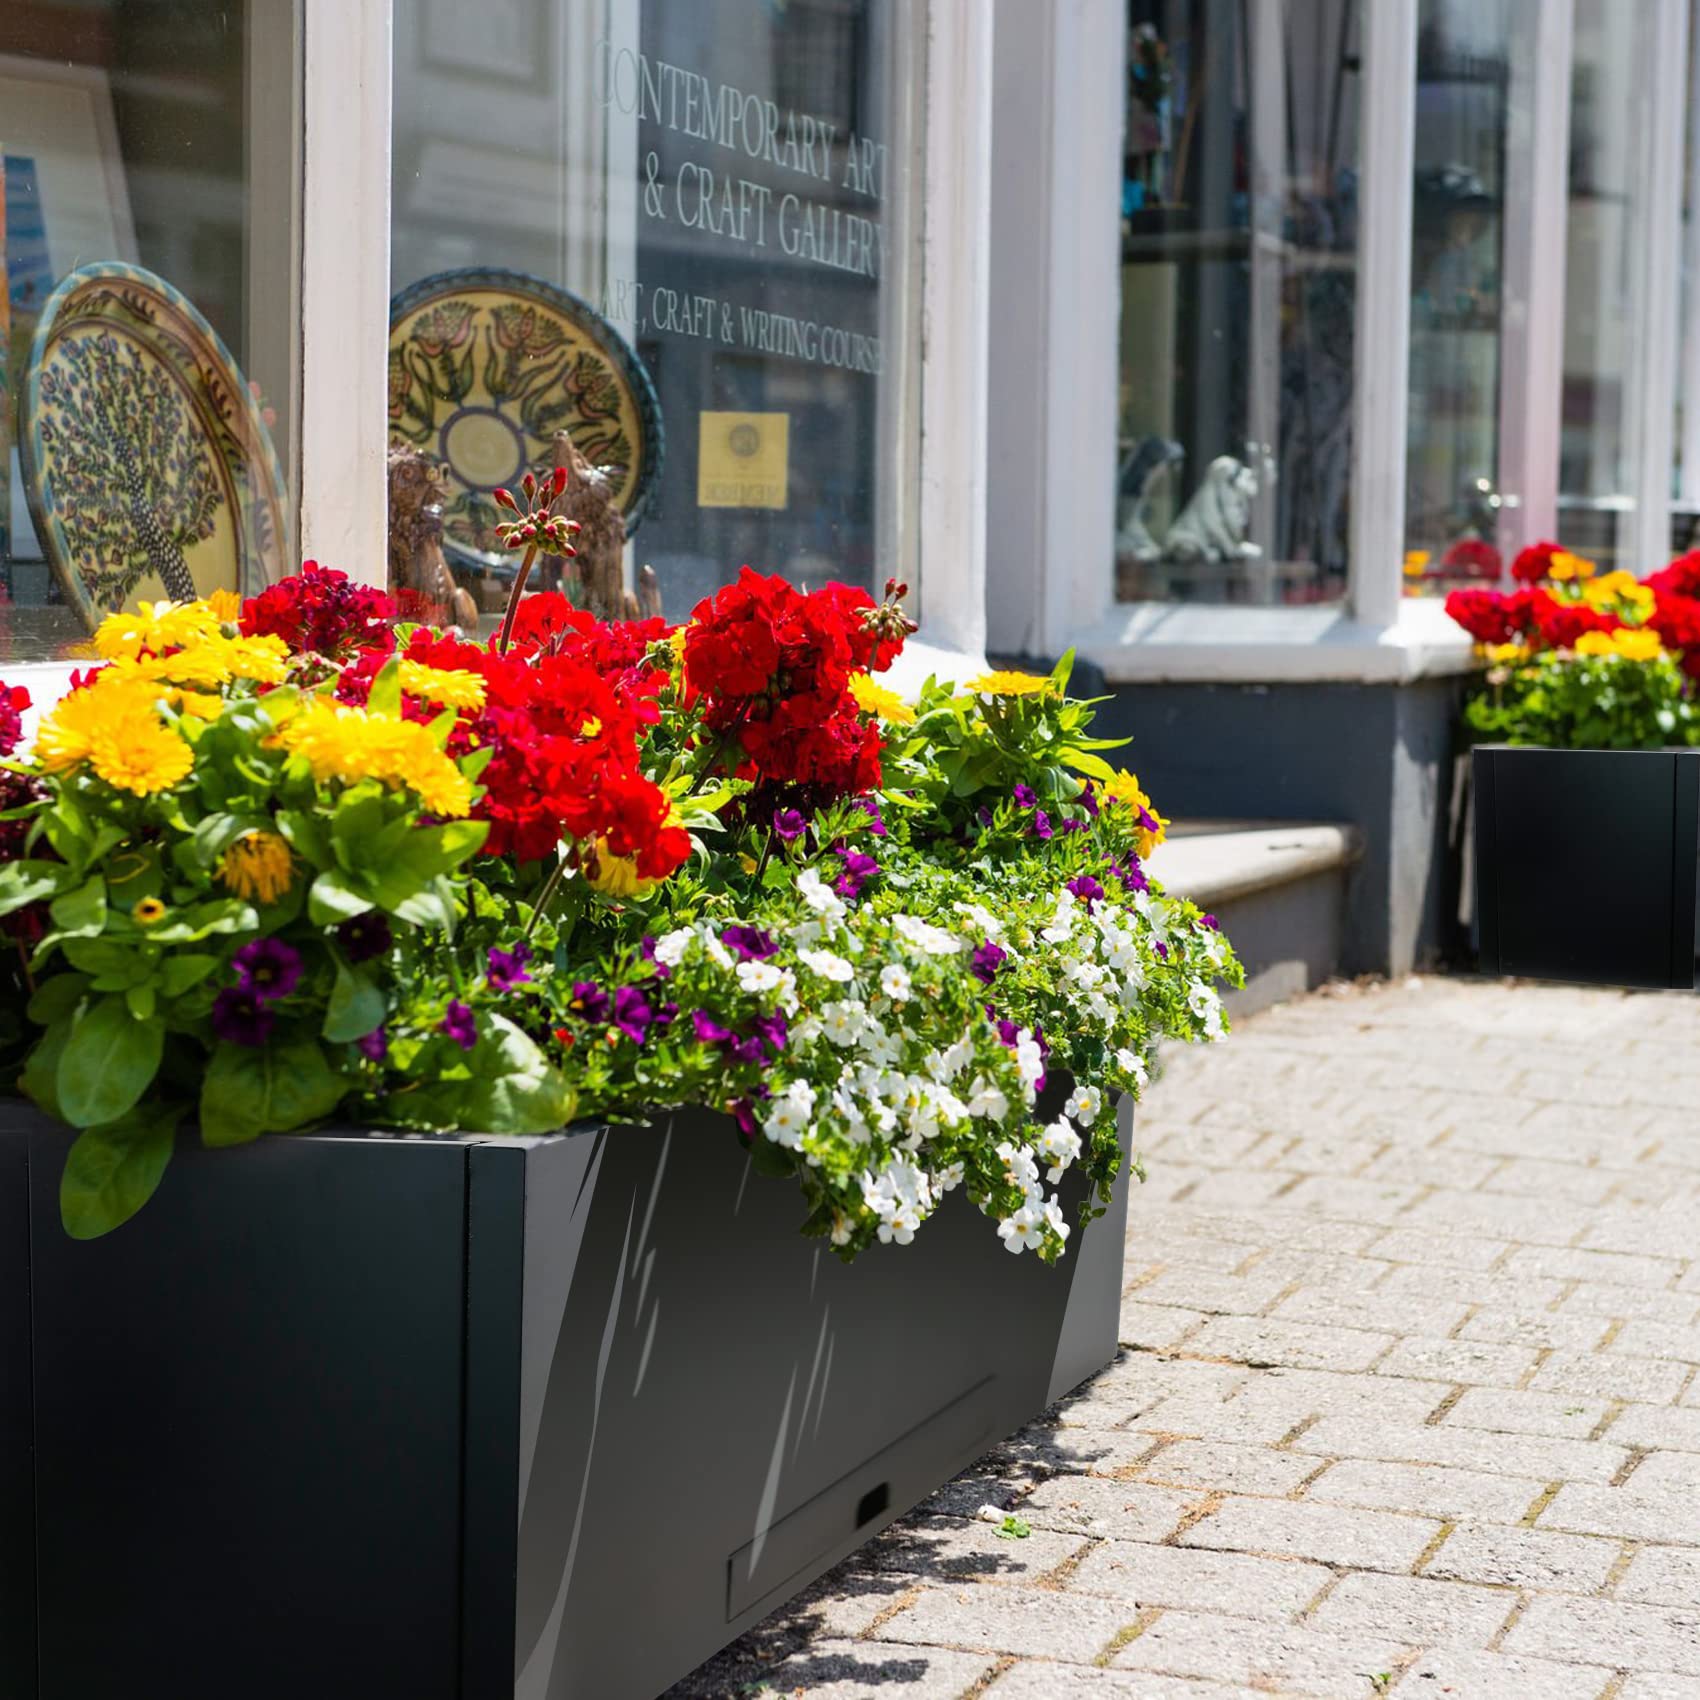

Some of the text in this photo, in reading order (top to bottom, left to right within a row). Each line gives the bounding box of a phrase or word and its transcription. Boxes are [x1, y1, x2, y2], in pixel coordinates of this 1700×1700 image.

[594, 41, 889, 202] CONTEMPORARY ART
[644, 152, 666, 219] &
[677, 162, 771, 247] CRAFT
[652, 287, 717, 339] CRAFT
[721, 302, 734, 344] &
[740, 306, 817, 361] WRITING
